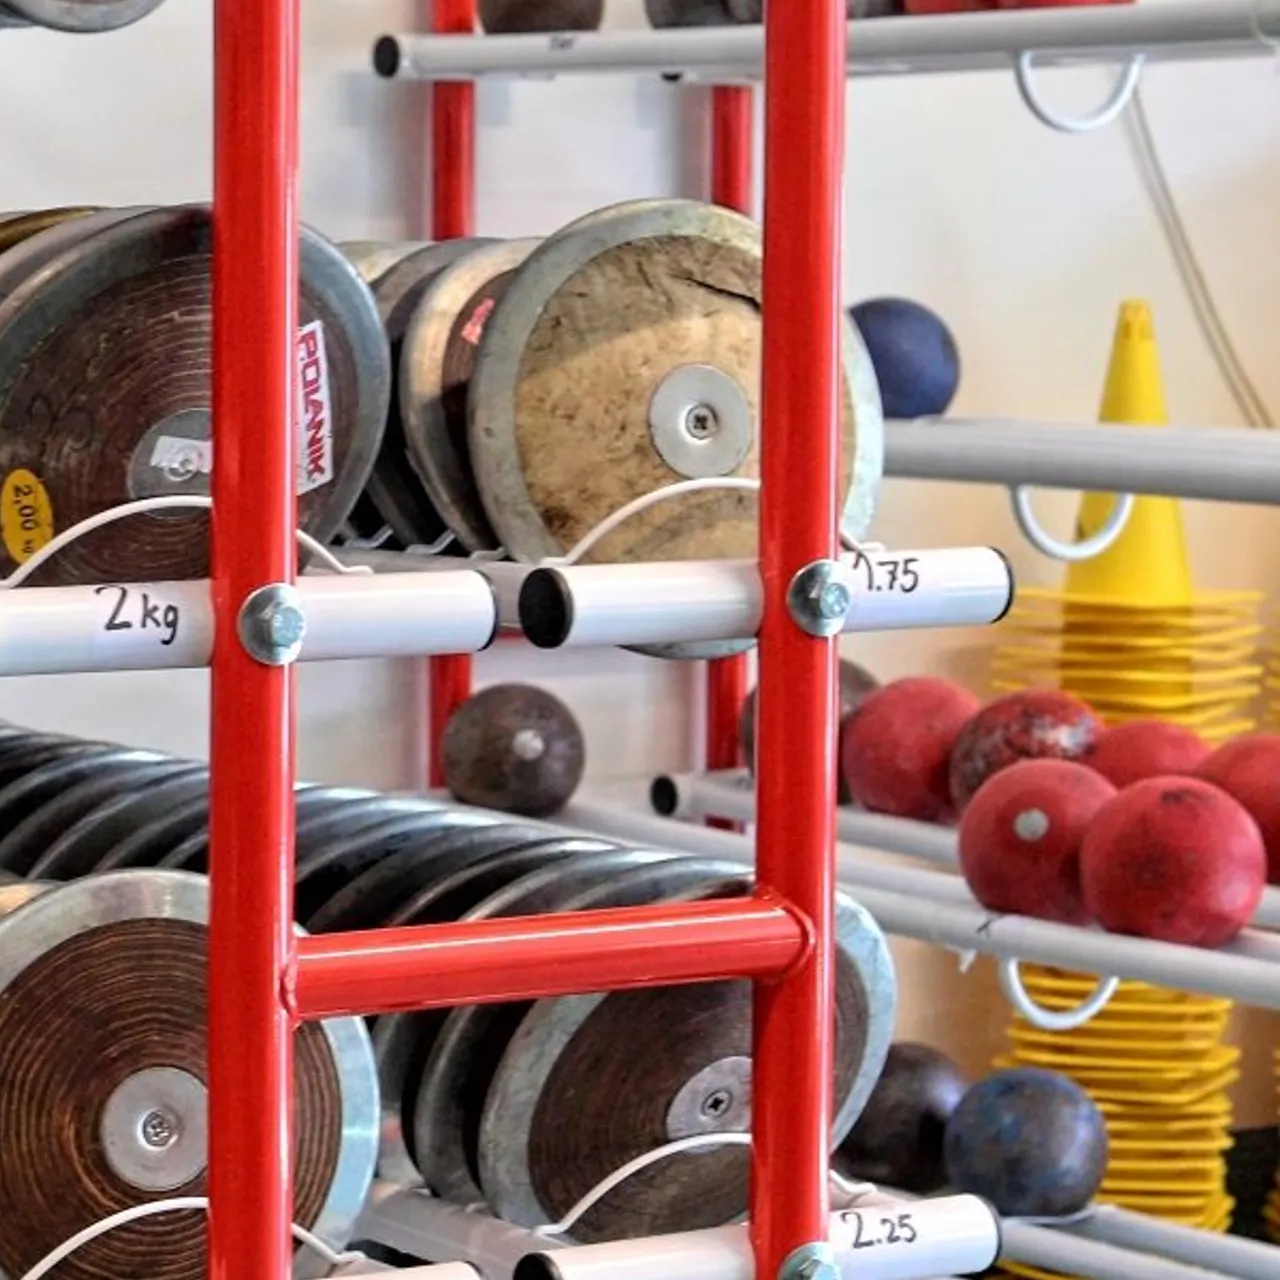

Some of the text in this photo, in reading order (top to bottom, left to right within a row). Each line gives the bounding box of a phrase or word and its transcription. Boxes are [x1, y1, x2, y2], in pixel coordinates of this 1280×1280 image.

[298, 329, 326, 477] POLANIK
[852, 550, 920, 594] 1.75
[94, 584, 179, 646] 2 kg
[840, 1211, 918, 1250] 2.25
